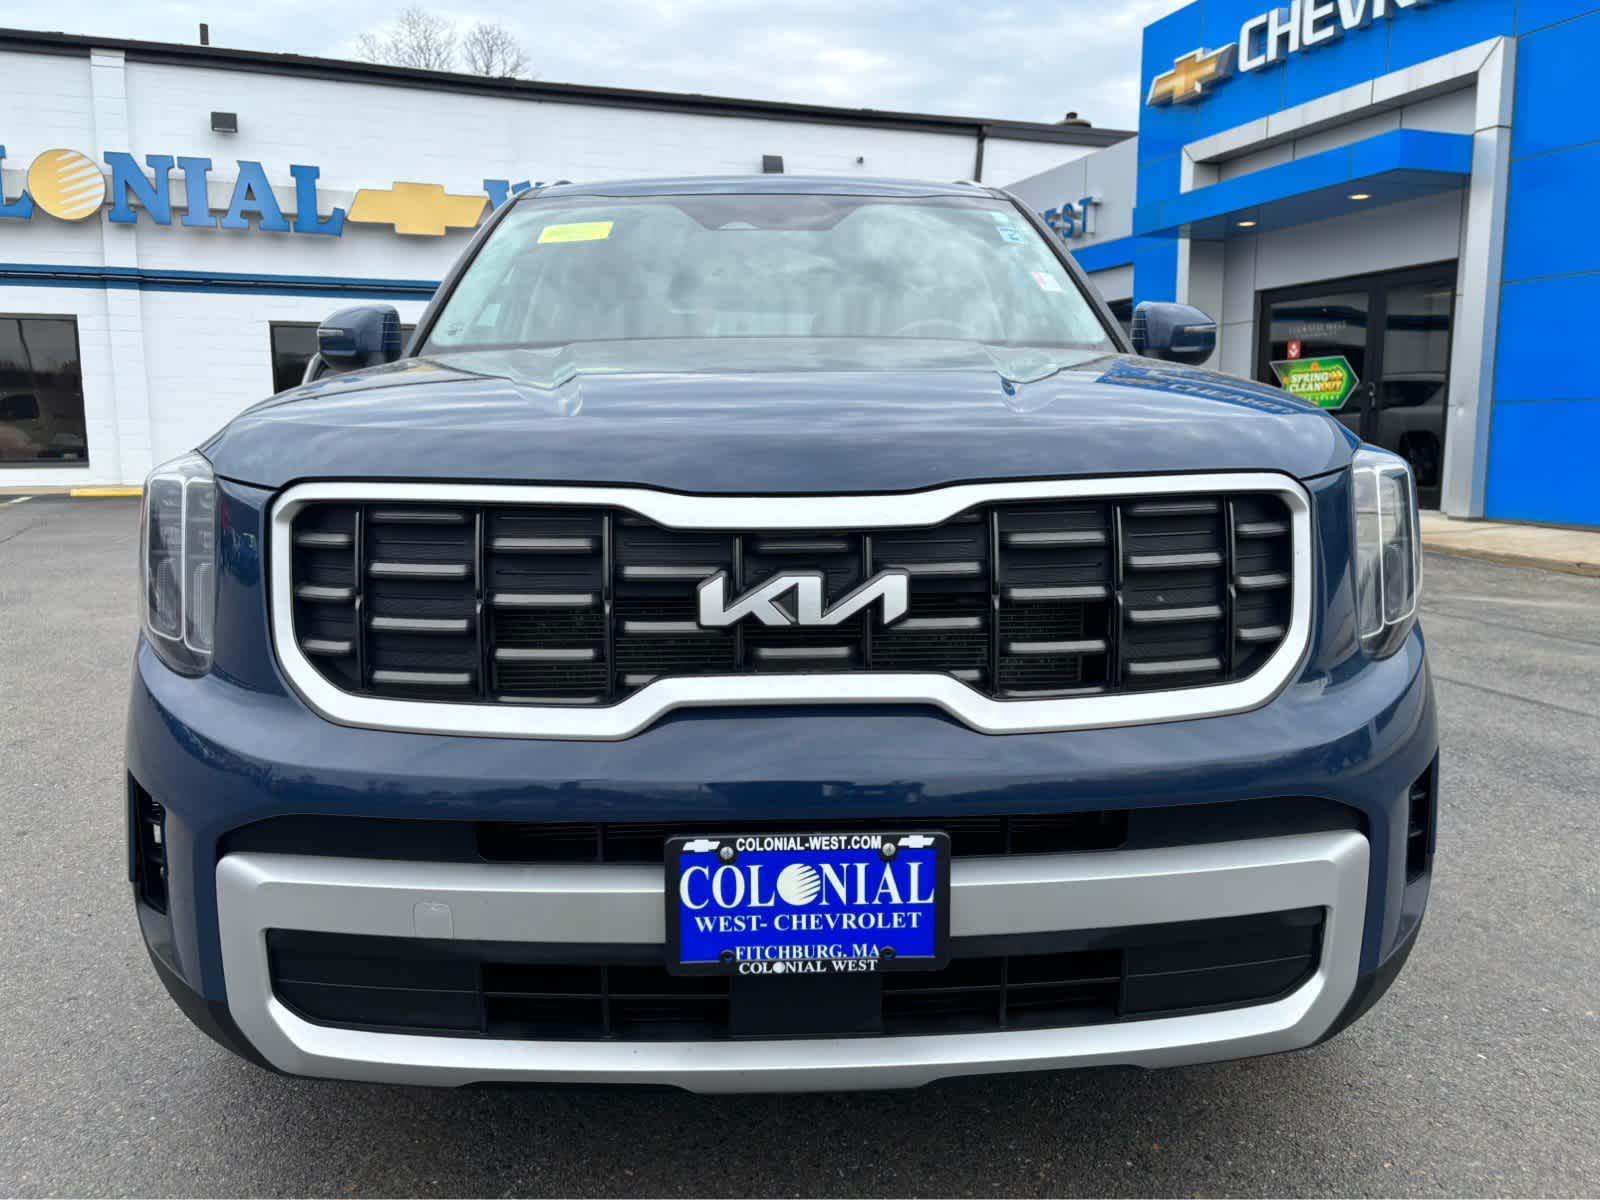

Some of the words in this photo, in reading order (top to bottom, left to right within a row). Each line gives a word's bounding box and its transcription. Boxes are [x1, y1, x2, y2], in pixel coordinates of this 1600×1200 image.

[1290, 371, 1329, 382] SPRING
[735, 836, 882, 851] COLONIAL-WEST.COM
[679, 862, 935, 909] COLONIAL
[773, 911, 922, 931] CHEVROLET
[852, 943, 880, 958] MA
[738, 960, 826, 974] COLONIAL
[832, 959, 878, 971] WEST
